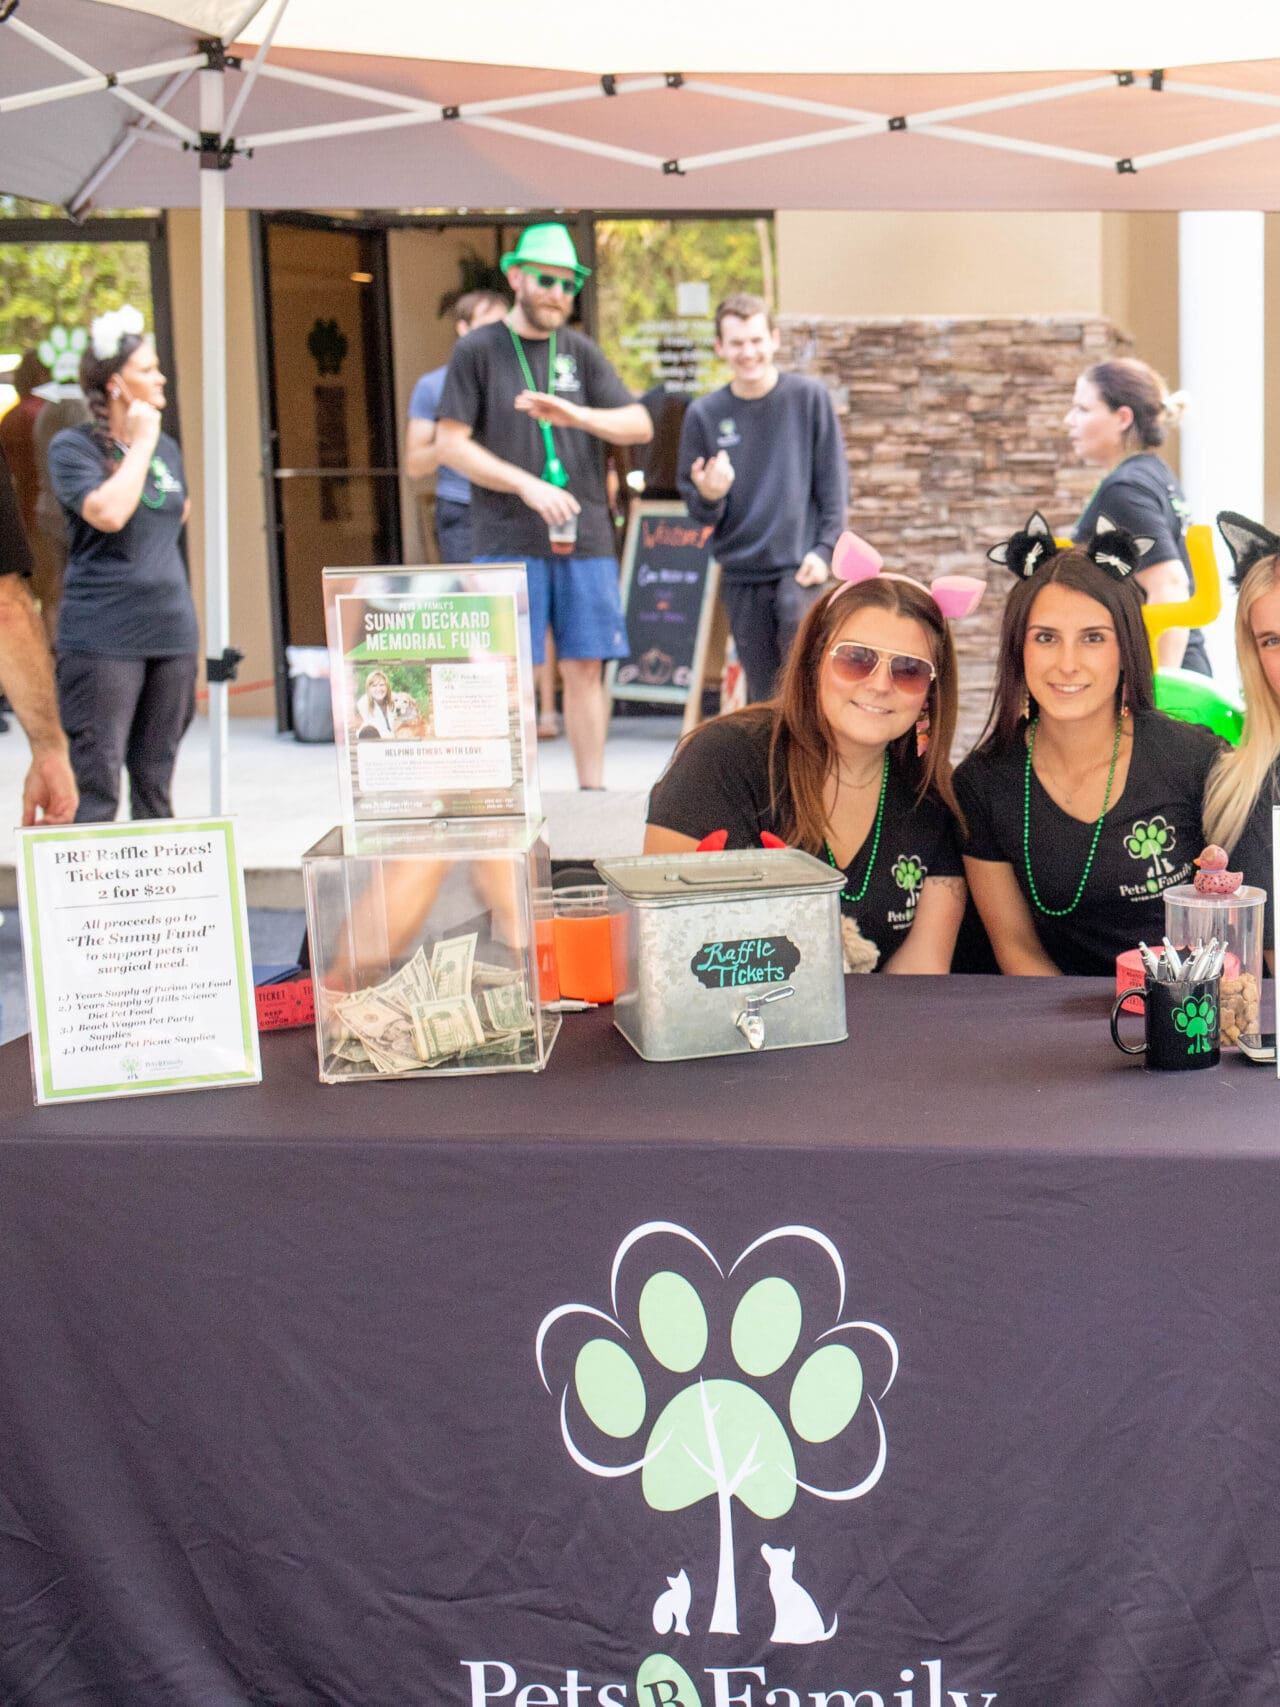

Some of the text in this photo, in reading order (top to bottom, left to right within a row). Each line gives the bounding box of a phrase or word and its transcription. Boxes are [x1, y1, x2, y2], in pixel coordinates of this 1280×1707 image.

[364, 611, 490, 631] SUNNY DECKARD
[366, 631, 490, 650] MEMORIAL FUND
[55, 842, 212, 864] PRF Raffle Prizes!
[65, 861, 203, 883] Tickets are sold
[98, 884, 176, 900] 2 for $20
[1119, 884, 1147, 896] Pets
[82, 913, 197, 930] All proceeds go to
[109, 932, 161, 945] Sunny
[86, 943, 199, 961] to support pets in
[697, 939, 776, 971] Raffle
[97, 958, 189, 975] surgical need.
[707, 960, 784, 987] Tickets
[75, 991, 103, 1000] Years
[105, 987, 140, 998] Supply
[208, 978, 232, 988] Food
[258, 990, 285, 1002] TICKET
[77, 1002, 105, 1010] Years
[108, 998, 142, 1008] Supply
[182, 992, 218, 1001] Science
[88, 1012, 108, 1020] Diet
[130, 1007, 153, 1016] Food
[79, 1022, 108, 1031] Beach
[167, 1015, 194, 1024] Party
[80, 1043, 121, 1052] Outdoor
[175, 1034, 216, 1044] Supplies
[90, 1031, 131, 1041] Supplies
[460, 1660, 629, 1707] Pets
[704, 1659, 997, 1707] Famil
